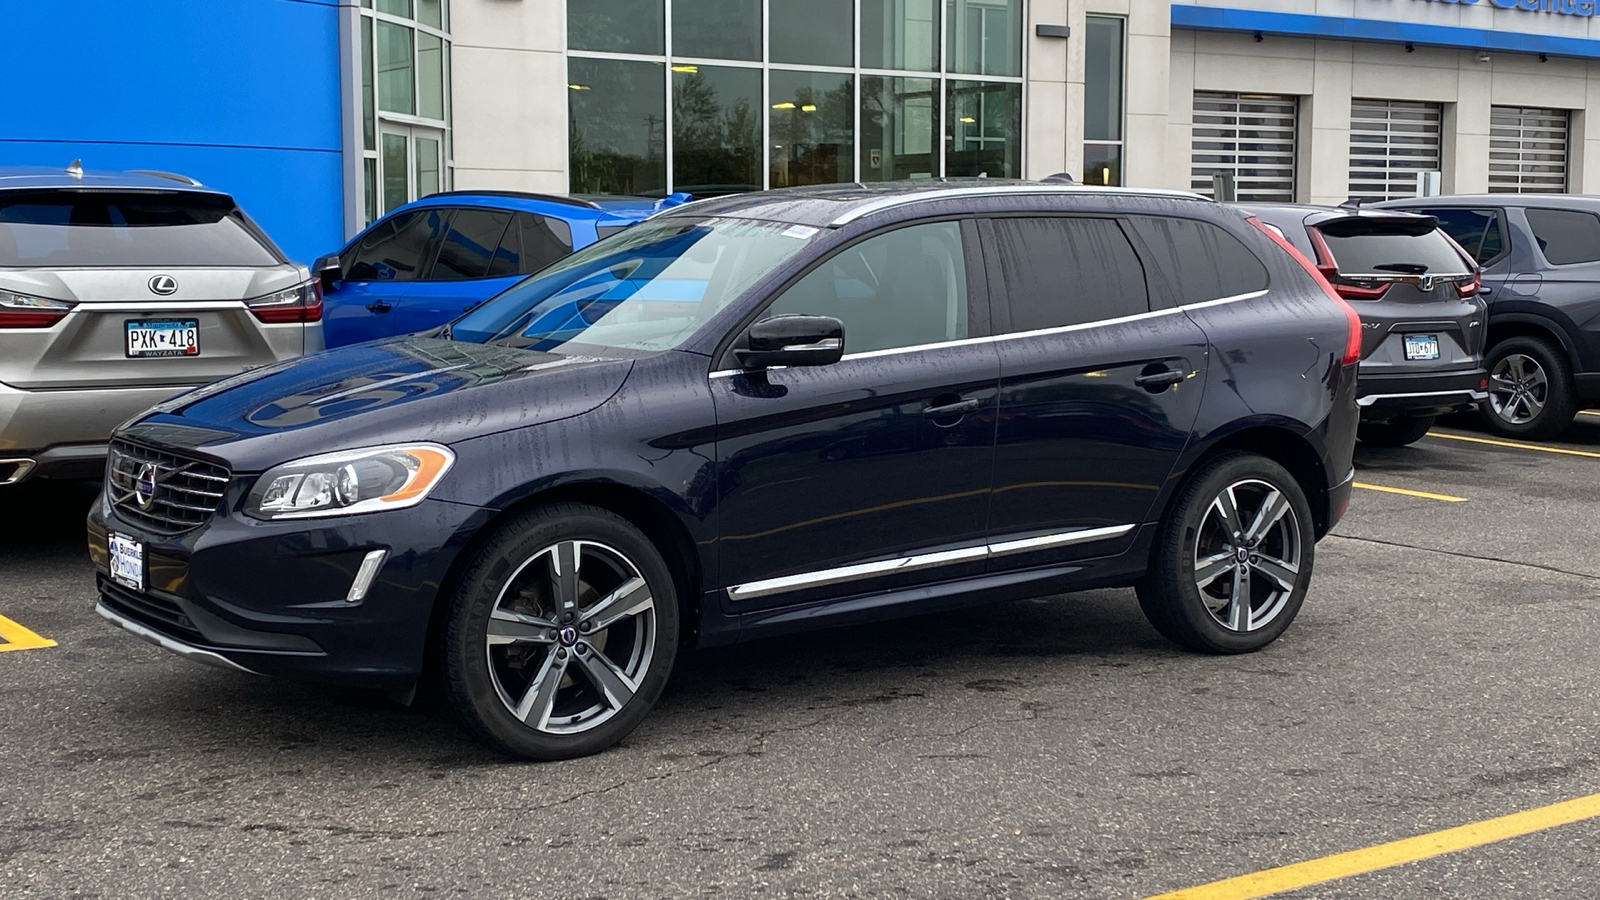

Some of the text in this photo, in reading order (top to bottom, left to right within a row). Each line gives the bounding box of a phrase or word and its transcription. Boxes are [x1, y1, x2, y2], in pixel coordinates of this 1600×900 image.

[131, 330, 194, 348] PXK 418
[1424, 341, 1436, 353] 677
